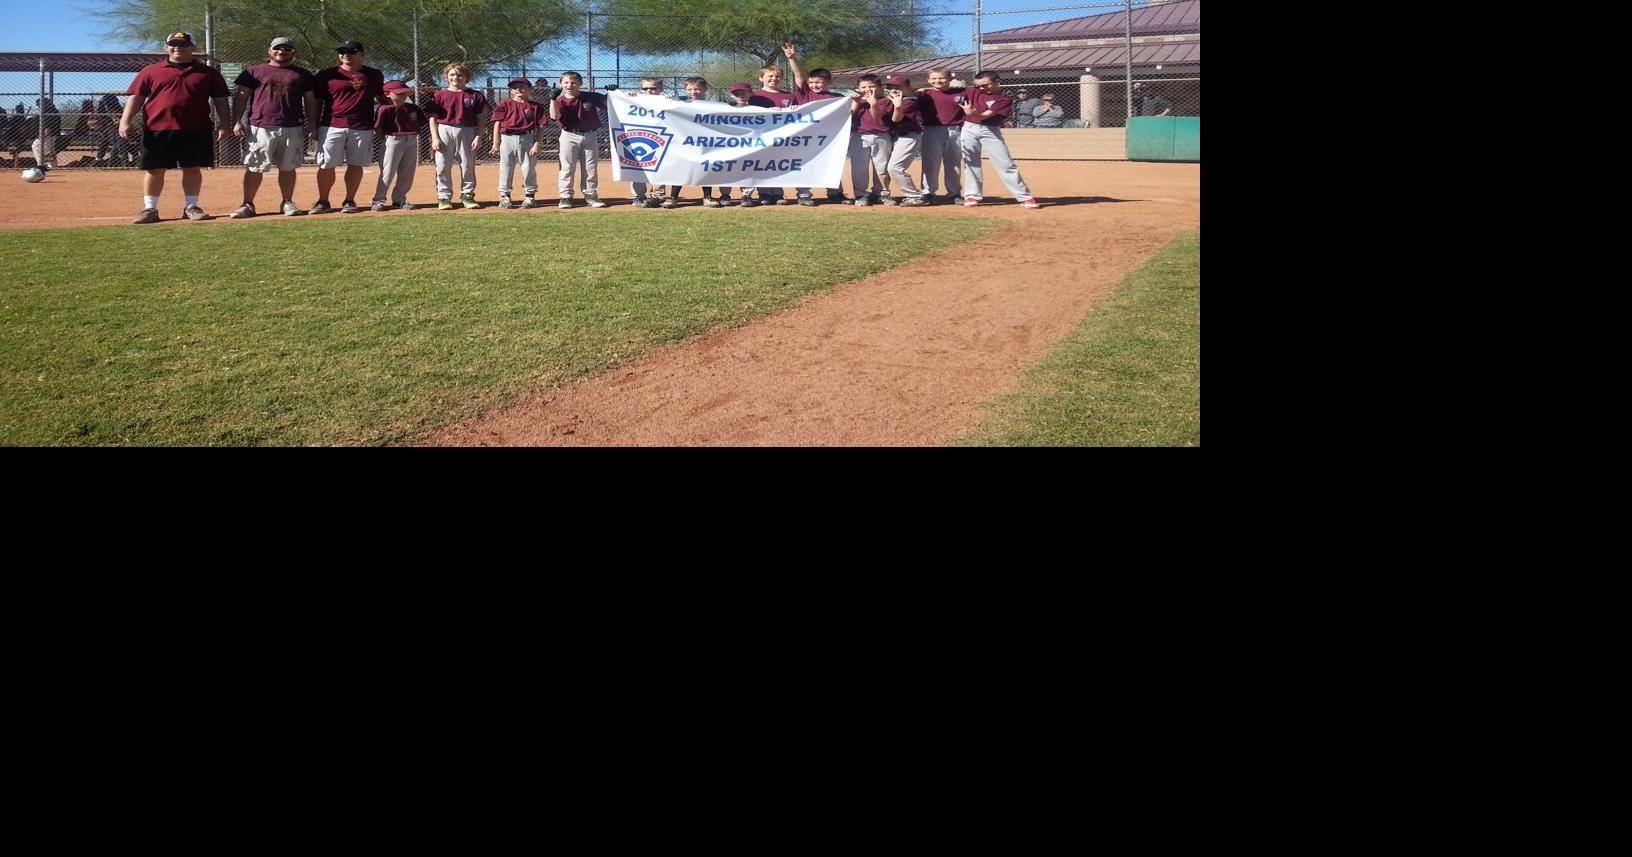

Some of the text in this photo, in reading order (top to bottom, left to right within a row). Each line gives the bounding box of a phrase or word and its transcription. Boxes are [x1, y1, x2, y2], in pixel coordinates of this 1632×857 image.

[628, 104, 667, 121] 2014
[694, 112, 820, 125] MINORS FALL
[683, 135, 827, 148] ARIZONA DIST 7
[701, 158, 802, 172] 1ST PLACE
